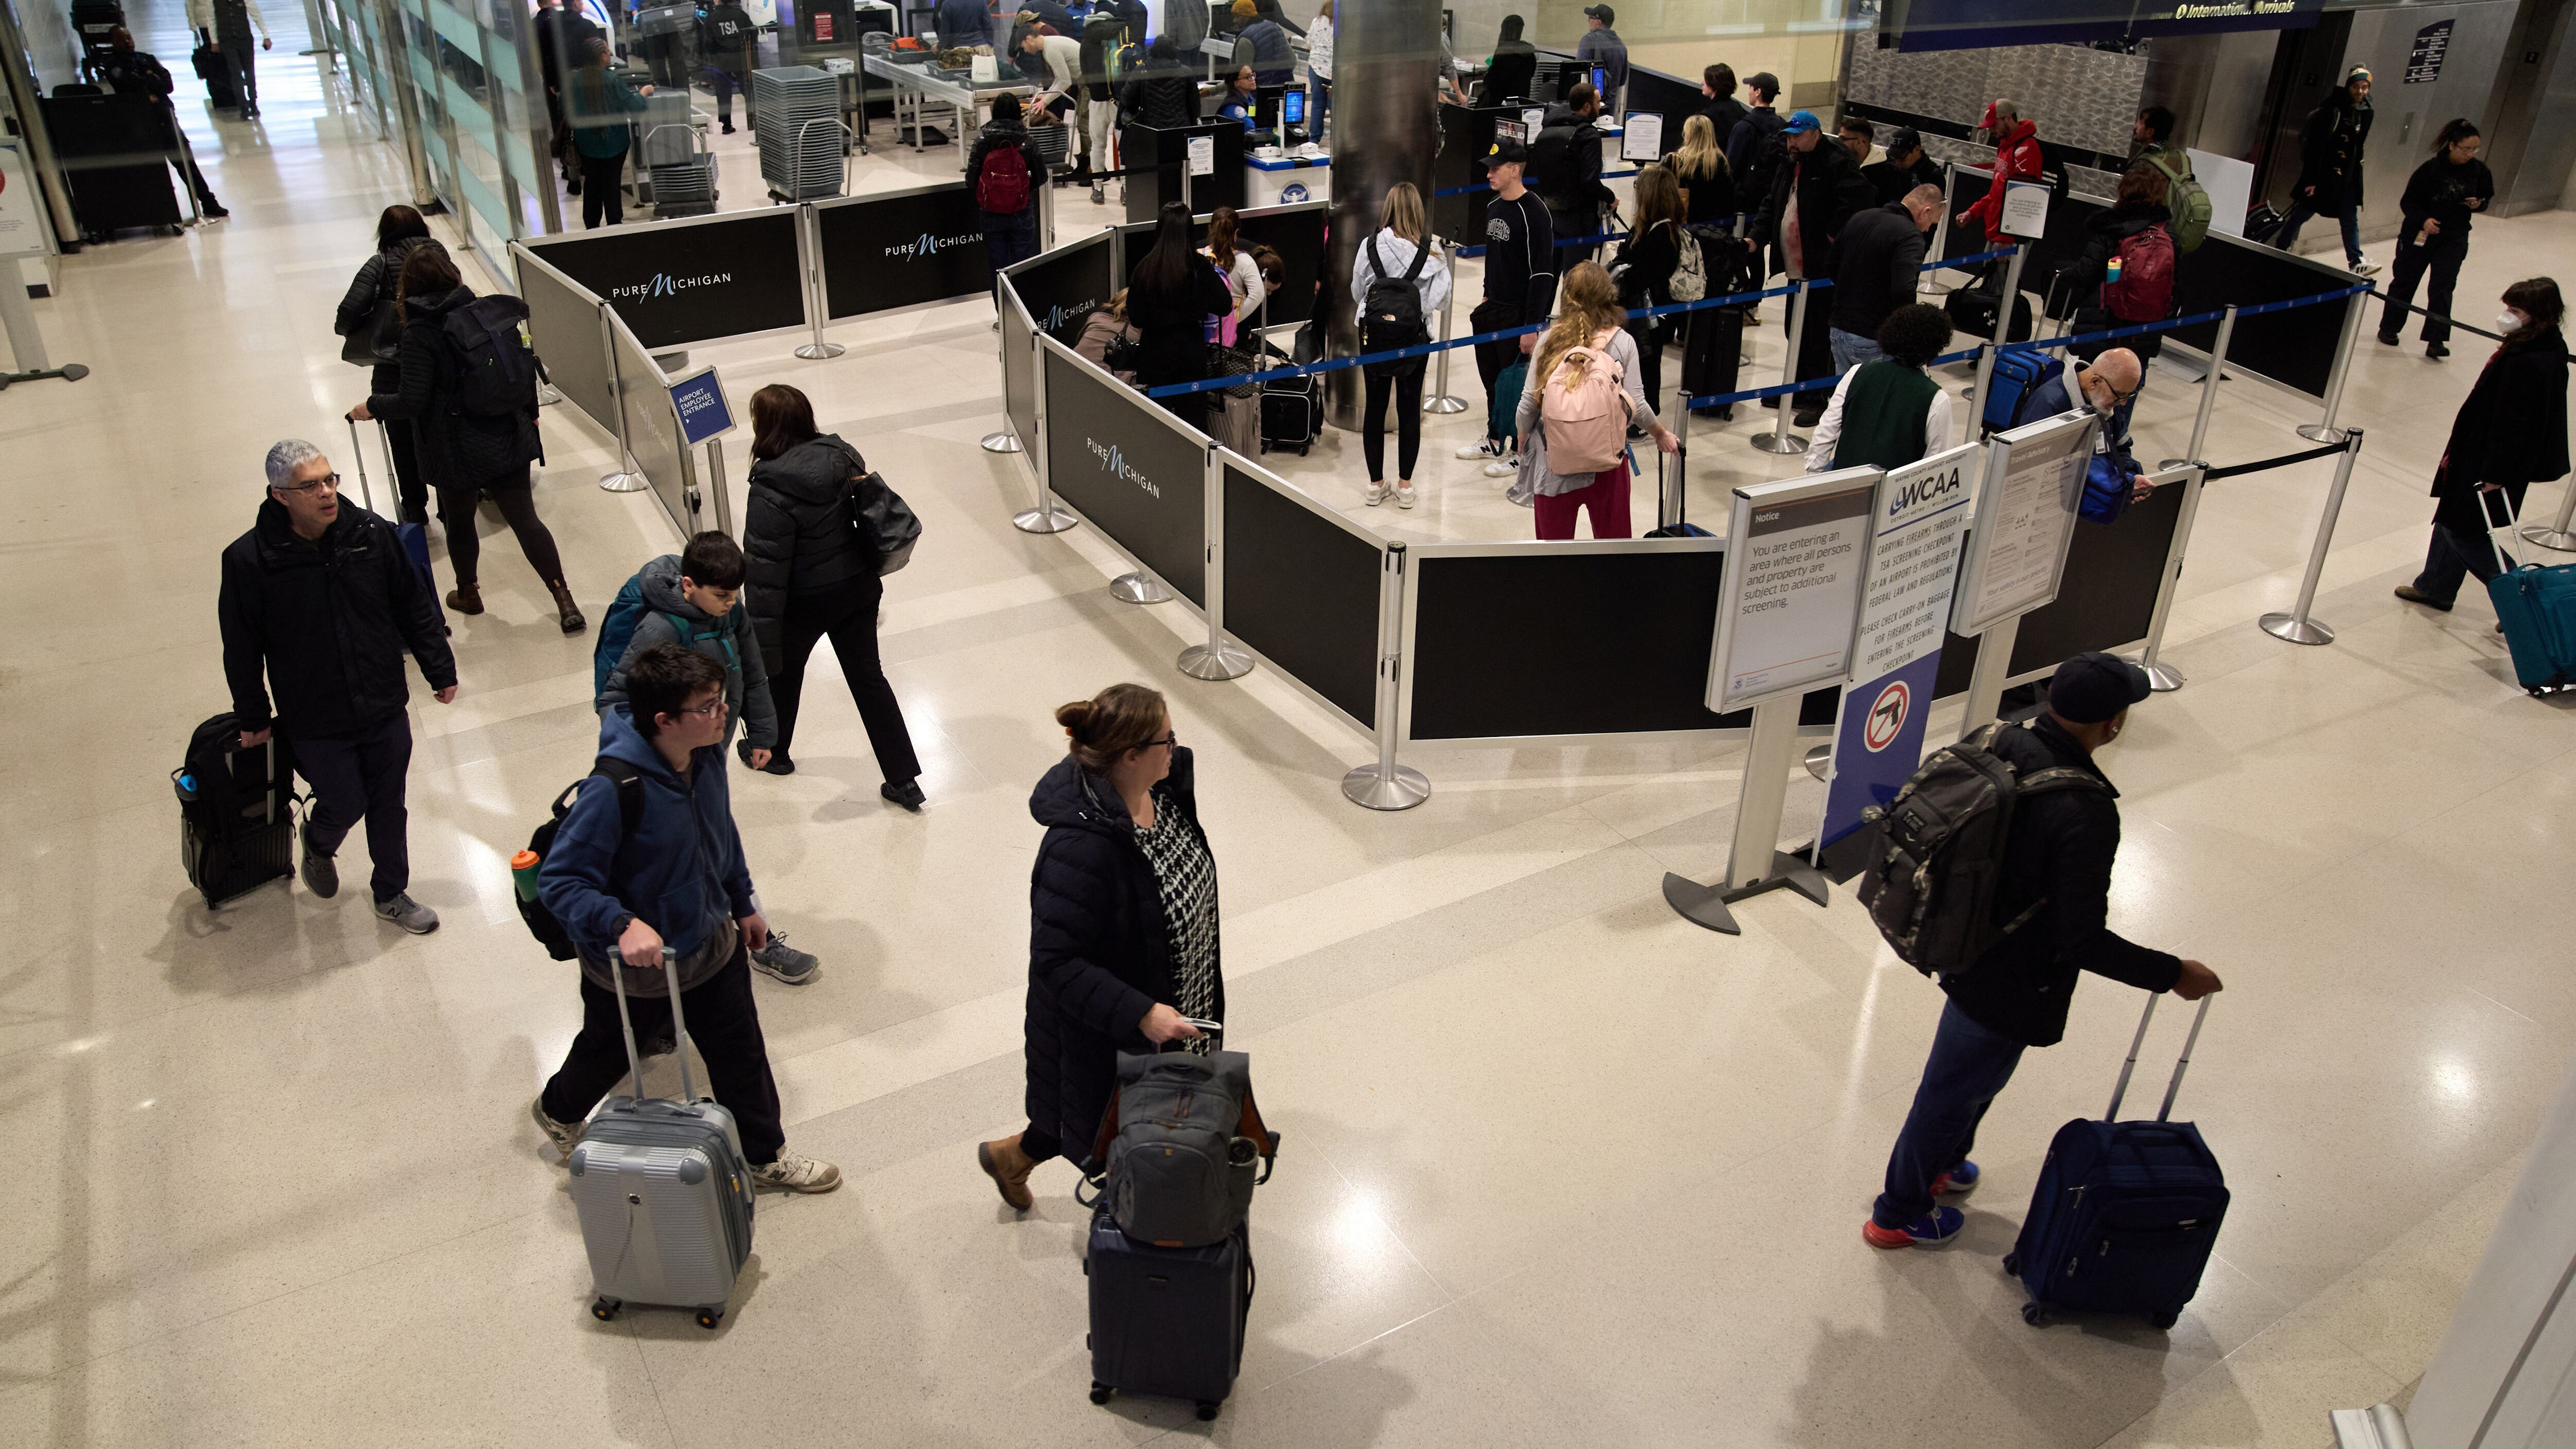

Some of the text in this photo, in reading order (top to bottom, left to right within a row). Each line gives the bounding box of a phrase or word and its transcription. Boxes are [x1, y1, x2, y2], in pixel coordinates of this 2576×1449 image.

[2254, 0, 2295, 15] Arrivals
[718, 21, 739, 35] TSA
[1486, 218, 1510, 241] QUEENS
[885, 233, 983, 262] PURE MICHIGAN
[613, 273, 731, 304] PURE MICHIGAN
[1037, 298, 1095, 331] RE MICHIGAN
[679, 388, 704, 404] AIRPORT
[680, 392, 712, 411] EMPLOYEE
[682, 398, 715, 416] ENTRANCE
[1087, 437, 1159, 499] PURE MICHIGAN
[1895, 453, 1967, 483] WAYNE COUNTY AIRPORT AUTHORITY
[2011, 446, 2051, 464] Travel Advisory
[1902, 467, 1959, 508] WCAA
[1755, 511, 1779, 523] Notice
[1891, 514, 1909, 523] DETROIT
[1910, 507, 1925, 515] METRO
[1932, 498, 1949, 506] WILLOW
[1753, 532, 1840, 557] You are entering an
[1877, 514, 1962, 556] CARRYING FIREARMS THROUGH A
[1750, 543, 1851, 572] area where all persons
[1880, 533, 1955, 572] TSA SCREENING CHECKPOINT
[1746, 563, 1824, 586] and property are
[1870, 546, 1958, 592] OF AN AIRPORT IS PROHIBITED BY
[1744, 572, 1836, 601] subject to additional
[1868, 564, 1953, 608] FEDERAL LAW AND REGULATIONS
[1742, 597, 1788, 614] screening.
[1861, 588, 1950, 636] PLEASE CHECK CARRY-ON BAGGAGE
[1874, 611, 1934, 646] FOR FIREARMS BEFORE
[1867, 626, 1935, 664] ENTERING THE SCREENING
[1883, 650, 1914, 672] CHECKPOINT
